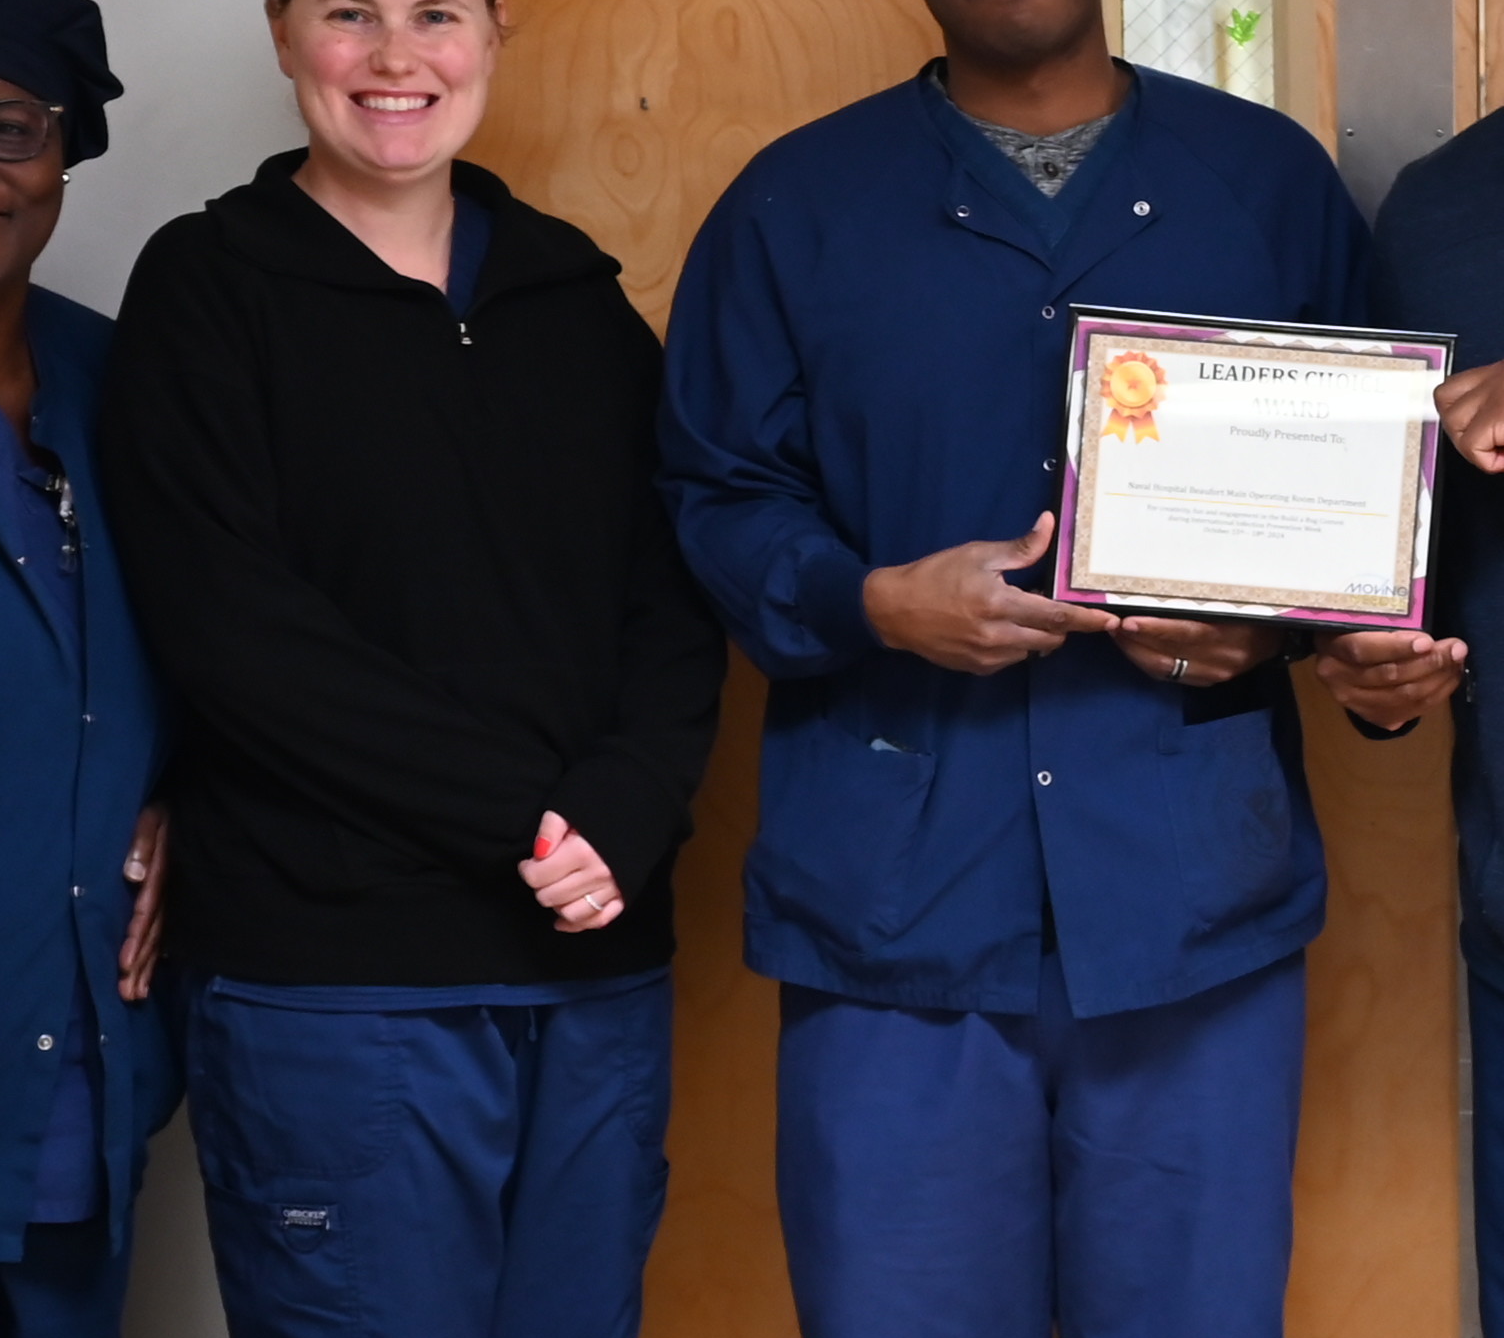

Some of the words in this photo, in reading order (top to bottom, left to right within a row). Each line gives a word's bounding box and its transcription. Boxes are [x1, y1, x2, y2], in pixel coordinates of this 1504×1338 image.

[1199, 362, 1299, 383] LEADERS
[1230, 425, 1271, 441] Proudly
[1274, 429, 1327, 443] Presented
[1330, 433, 1345, 444] To:
